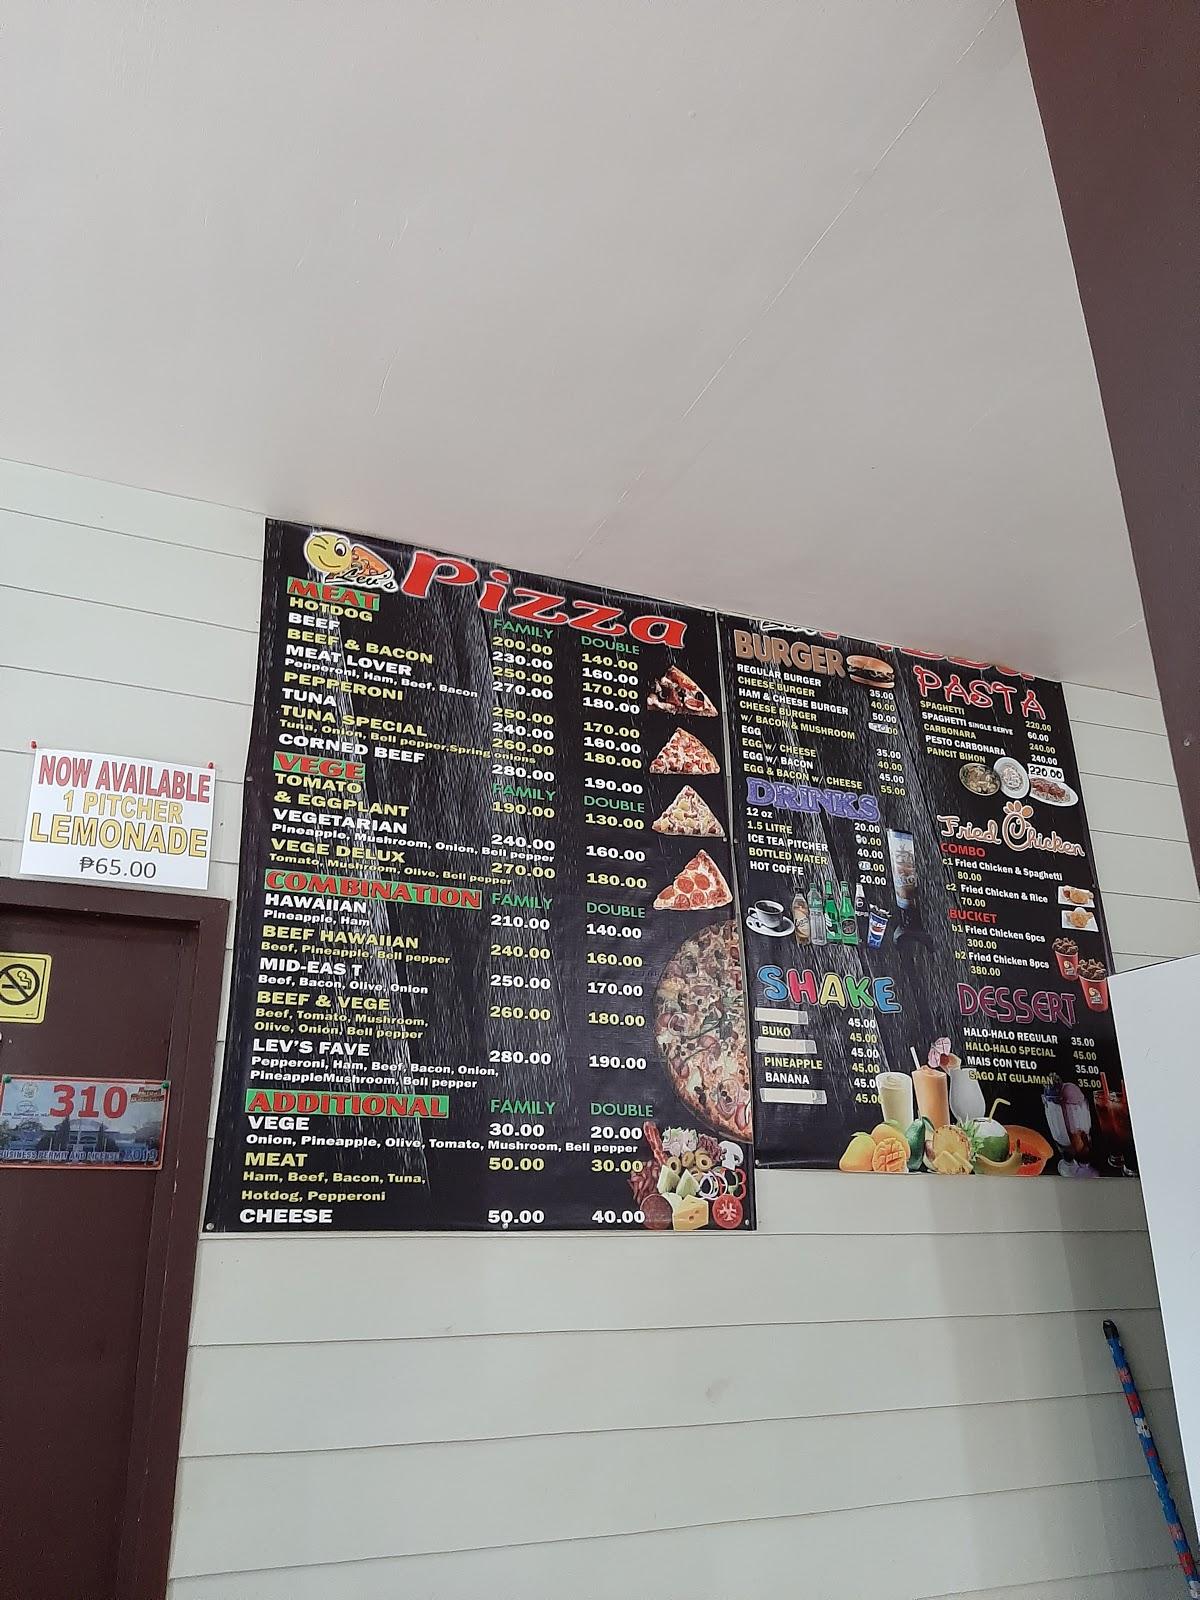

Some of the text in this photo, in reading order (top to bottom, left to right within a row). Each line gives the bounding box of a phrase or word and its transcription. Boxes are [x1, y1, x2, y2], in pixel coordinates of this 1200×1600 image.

[289, 580, 378, 609] MEAT
[402, 551, 687, 649] Pizza
[290, 597, 372, 622] HOTDOG
[289, 613, 340, 630] BEEF
[494, 619, 554, 639] FAMILY
[287, 628, 433, 664] BEEF & BACON
[493, 637, 552, 655] 200.00
[581, 636, 639, 655] DOUBLE
[734, 630, 846, 678] BURGER
[286, 645, 412, 676] MEAT LOVER
[493, 651, 553, 670] 230.00
[582, 654, 638, 671] 140.00
[737, 664, 821, 686] REGULAR BURGER
[284, 672, 403, 700] PEPPERONI
[493, 682, 553, 700] 270.00
[738, 676, 815, 697] CHEESE BURGER
[870, 689, 893, 700] 35.00
[913, 665, 1045, 720] PASTA
[282, 688, 336, 706] TUNA
[739, 688, 848, 715] HAM & CHEESE BURGER
[871, 701, 895, 712] 40.00
[920, 700, 964, 715] SPAGHETTI
[281, 705, 427, 736] TUNA SPECIAL
[872, 713, 896, 723] 50.00
[922, 712, 1013, 735] SPAGHETTI SINGLE SERVE
[1026, 721, 1051, 732] 220.00
[742, 725, 761, 736] EGG
[924, 723, 976, 739] CARBONARA
[1028, 732, 1048, 742] 60.00
[279, 733, 425, 763] CORNED BEEF
[742, 738, 816, 757] EGG w/ CHEESE
[877, 749, 900, 759] 35.00
[926, 735, 1006, 756] PESTO CARBONARA
[927, 747, 986, 763] PANCIT BIHON
[1032, 755, 1057, 765] 240.00
[276, 753, 364, 780] VEGE
[492, 764, 554, 781] 280.00
[38, 755, 210, 803] NOW AVAILABLE
[275, 773, 362, 793] TOMATO
[63, 790, 183, 824] 1 PITCHER
[274, 791, 409, 816] & EGGPLANT
[746, 777, 880, 822] DRINKS
[273, 808, 407, 834] VEGETARIAN
[585, 813, 644, 830] 130.00
[746, 807, 773, 819] 12 oz
[30, 813, 208, 858] LEMONADE
[747, 821, 793, 834] 1.5 LITRE
[855, 823, 880, 833] 20.00
[937, 813, 1085, 856] Fried Chicken
[272, 838, 406, 863] VEGE DELUX
[748, 834, 828, 851] ICE TEA PITCHER
[940, 843, 986, 857] COMBO
[749, 848, 828, 865] BOTTLED WATER
[857, 849, 883, 859] 40.00
[492, 863, 555, 878] 270.00
[750, 861, 804, 876] HOT COFFE
[942, 858, 1062, 881] c1 Fried Chicken & Spaghetti
[958, 871, 982, 881] 80.00
[860, 874, 886, 885] 20.00
[266, 871, 480, 908] COMBINATION
[265, 894, 366, 913] HAWAIIAN
[264, 910, 369, 926] Pineapple, Ham
[491, 915, 549, 930] 210.00
[949, 909, 997, 923] BUCKET
[262, 925, 418, 949] BEEF HAWAIIAN
[586, 924, 641, 939] 140.00
[952, 924, 1045, 942] b1 Fried Chicken 6pcs
[967, 939, 997, 949] 300.00
[758, 965, 901, 1013] SHAKE
[257, 992, 390, 1010] BEEF & VEGE
[958, 982, 1076, 1029] DESSERT
[762, 1026, 791, 1036] BUKO
[848, 1018, 876, 1028] 45.00
[964, 1028, 1058, 1044] HALO-HALO REGULAR
[1071, 1037, 1094, 1047] 35.00
[319, 1042, 370, 1056] FAVE
[966, 1042, 1056, 1058] HALO-HALO SPECIAL
[1074, 1051, 1096, 1061] 45.00
[252, 1057, 498, 1077] Pepperoni, Ham, Beef, Bacon, Onion,
[764, 1057, 823, 1070] PINEAPPLE
[967, 1056, 1037, 1070] MAIS CON YELO
[766, 1072, 809, 1084] BANANA
[50, 1085, 127, 1118] 310
[248, 1092, 447, 1117] ADDITIONAL
[491, 1100, 556, 1115] FAMILY
[591, 1103, 653, 1116] DOUBLE
[248, 1117, 309, 1130] VEGE
[489, 1124, 544, 1136] 30.00
[591, 1127, 642, 1139] 20.00
[246, 1134, 637, 1153] Onion, Pineapple, Olive, Tomato, Mushroom, Bell pepper
[245, 1153, 307, 1166] MEAT
[242, 1191, 386, 1202] Hotdog, Pepperoni
[240, 1210, 332, 1223] CHEESE
[488, 1211, 544, 1223] 50.00
[592, 1211, 645, 1223] 40.00
